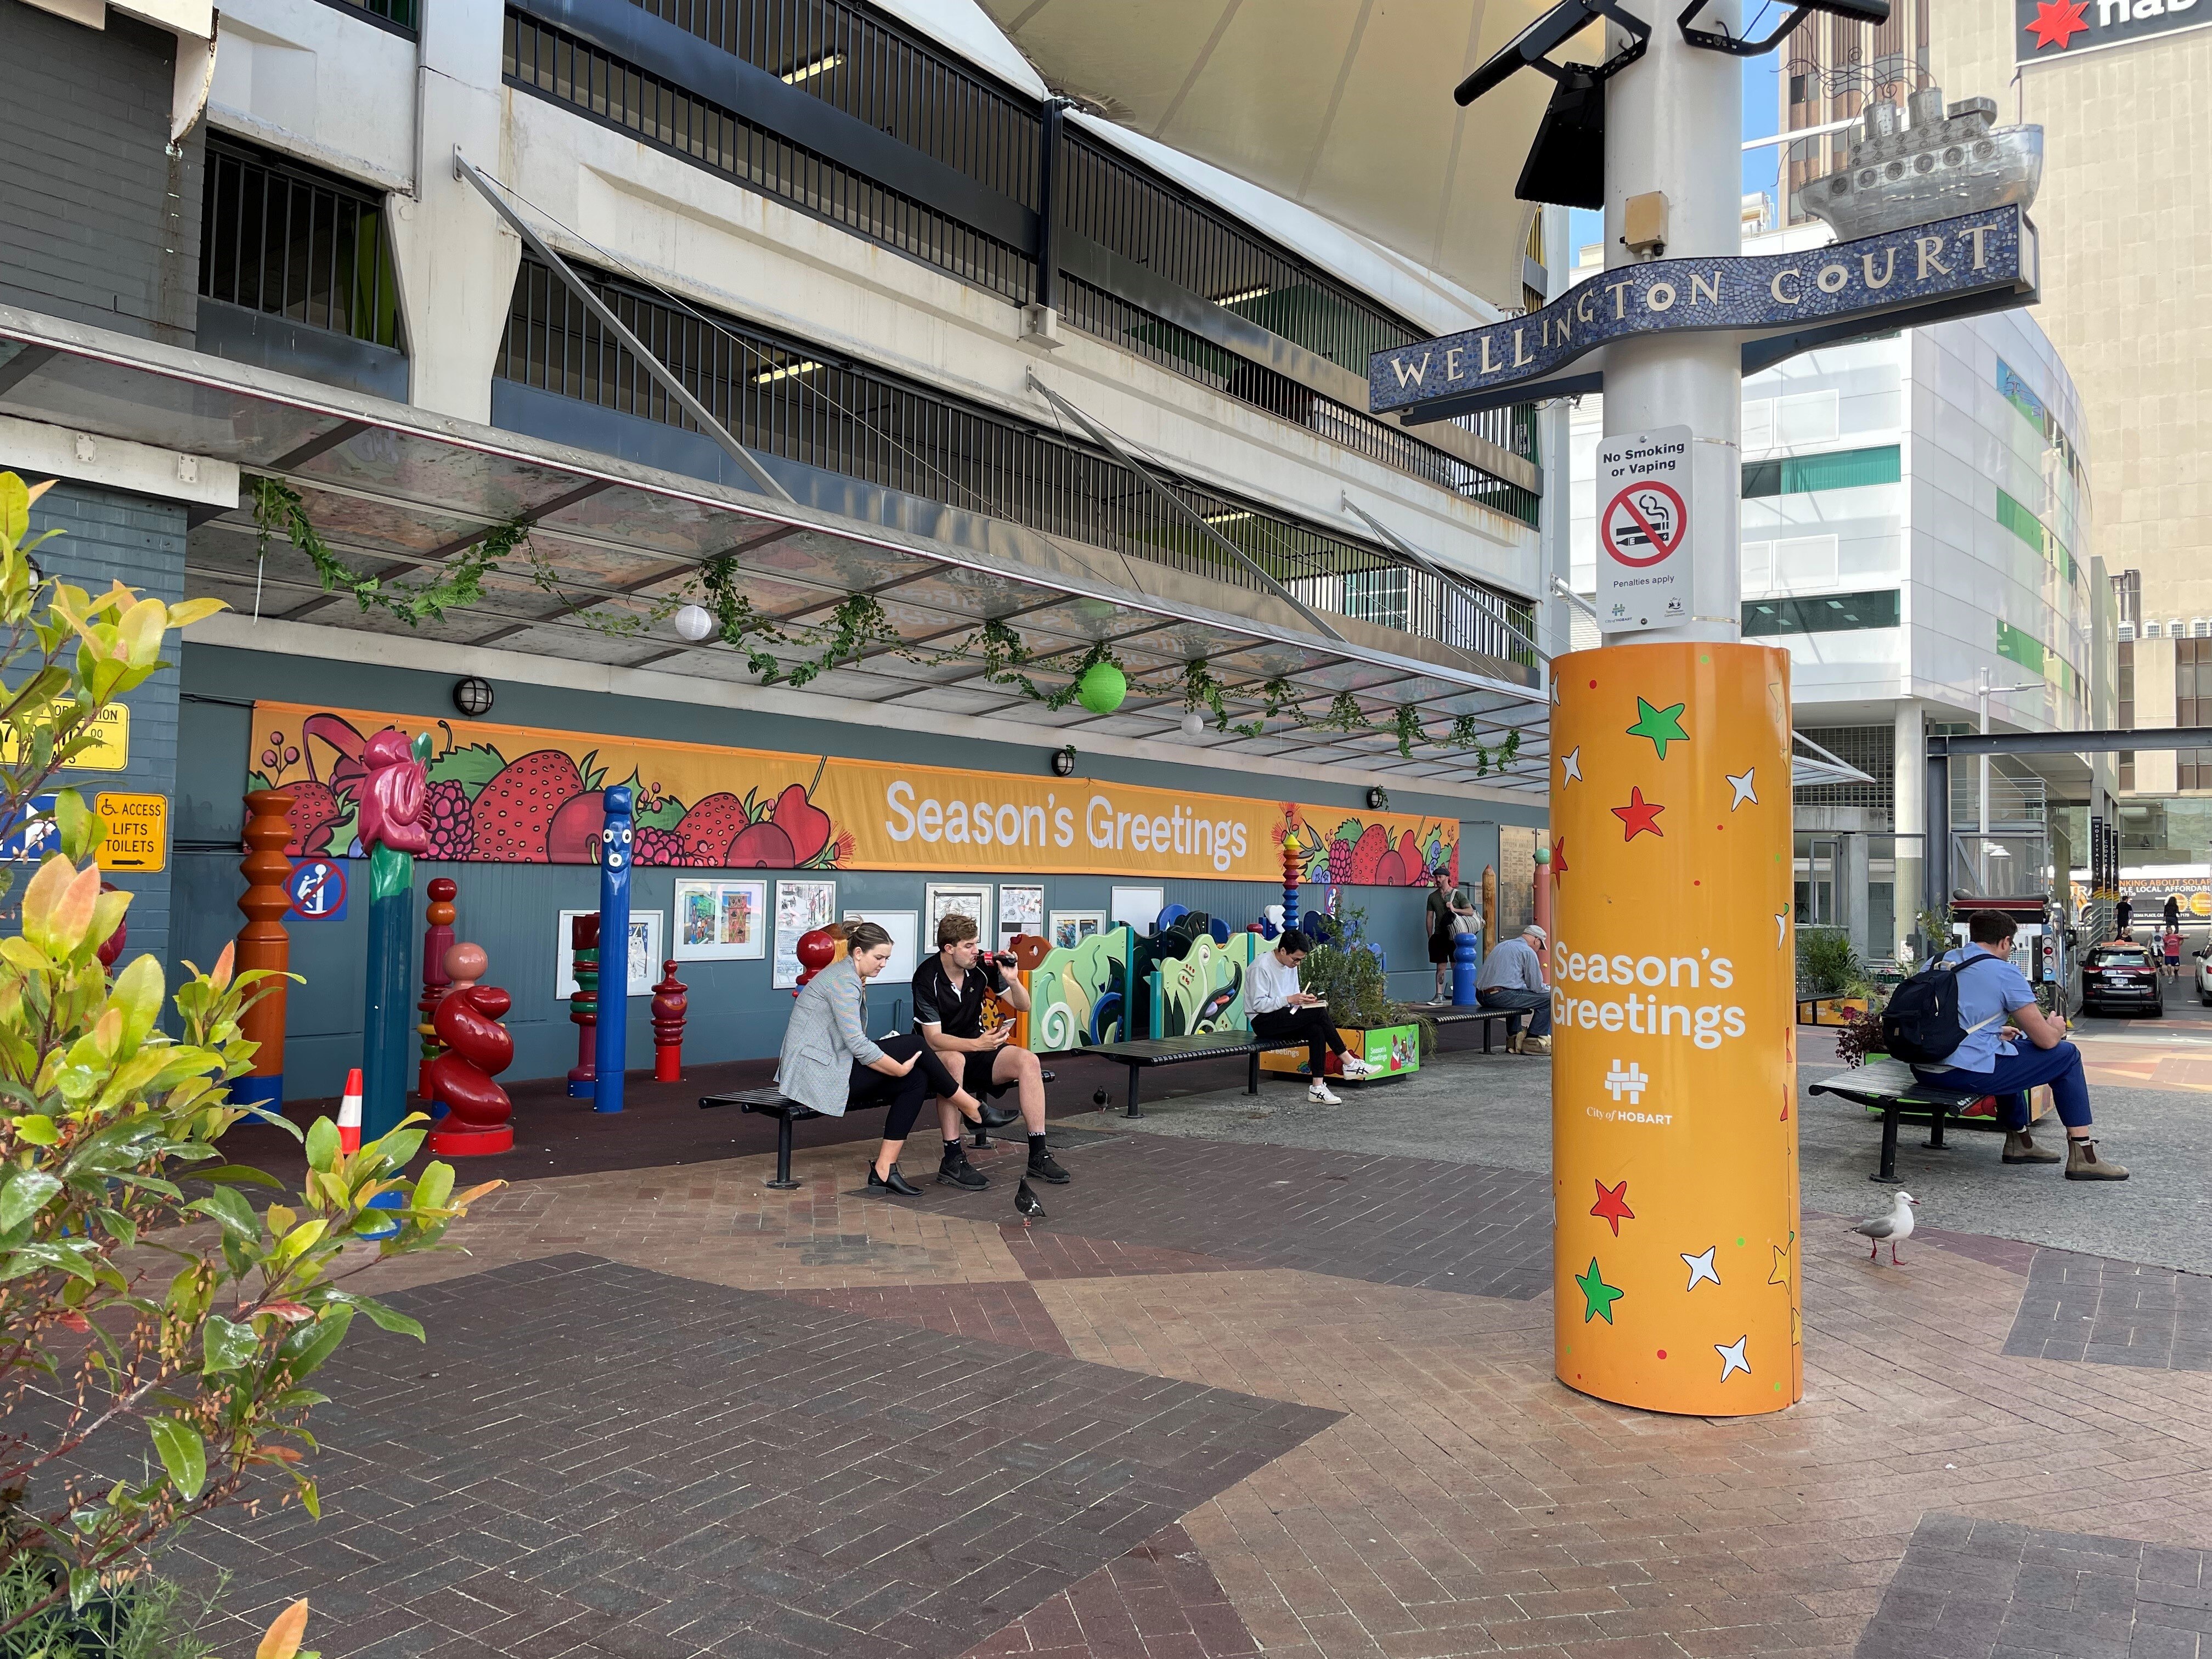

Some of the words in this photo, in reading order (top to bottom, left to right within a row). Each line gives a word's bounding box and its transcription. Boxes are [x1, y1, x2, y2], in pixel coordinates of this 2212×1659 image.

[1390, 270, 1723, 388] WELLINGTON
[1770, 223, 1997, 304] COURT
[1603, 453, 1621, 464] No
[1625, 443, 1685, 460] Smoking
[1611, 467, 1625, 477] or
[1629, 460, 1676, 475] Vaping
[1613, 578, 1650, 588] Penalties
[1652, 575, 1675, 584] apply
[121, 803, 161, 816] ACCESS
[112, 822, 148, 836] LIFTS
[1087, 794, 1247, 872] Greetings
[105, 839, 154, 853] TOILETS
[1551, 986, 1746, 1050] Greetings
[1369, 1053, 1387, 1062] Greetings
[1586, 1106, 1605, 1120] City
[1605, 1109, 1618, 1122] of
[1617, 1110, 1673, 1125] HOBART
